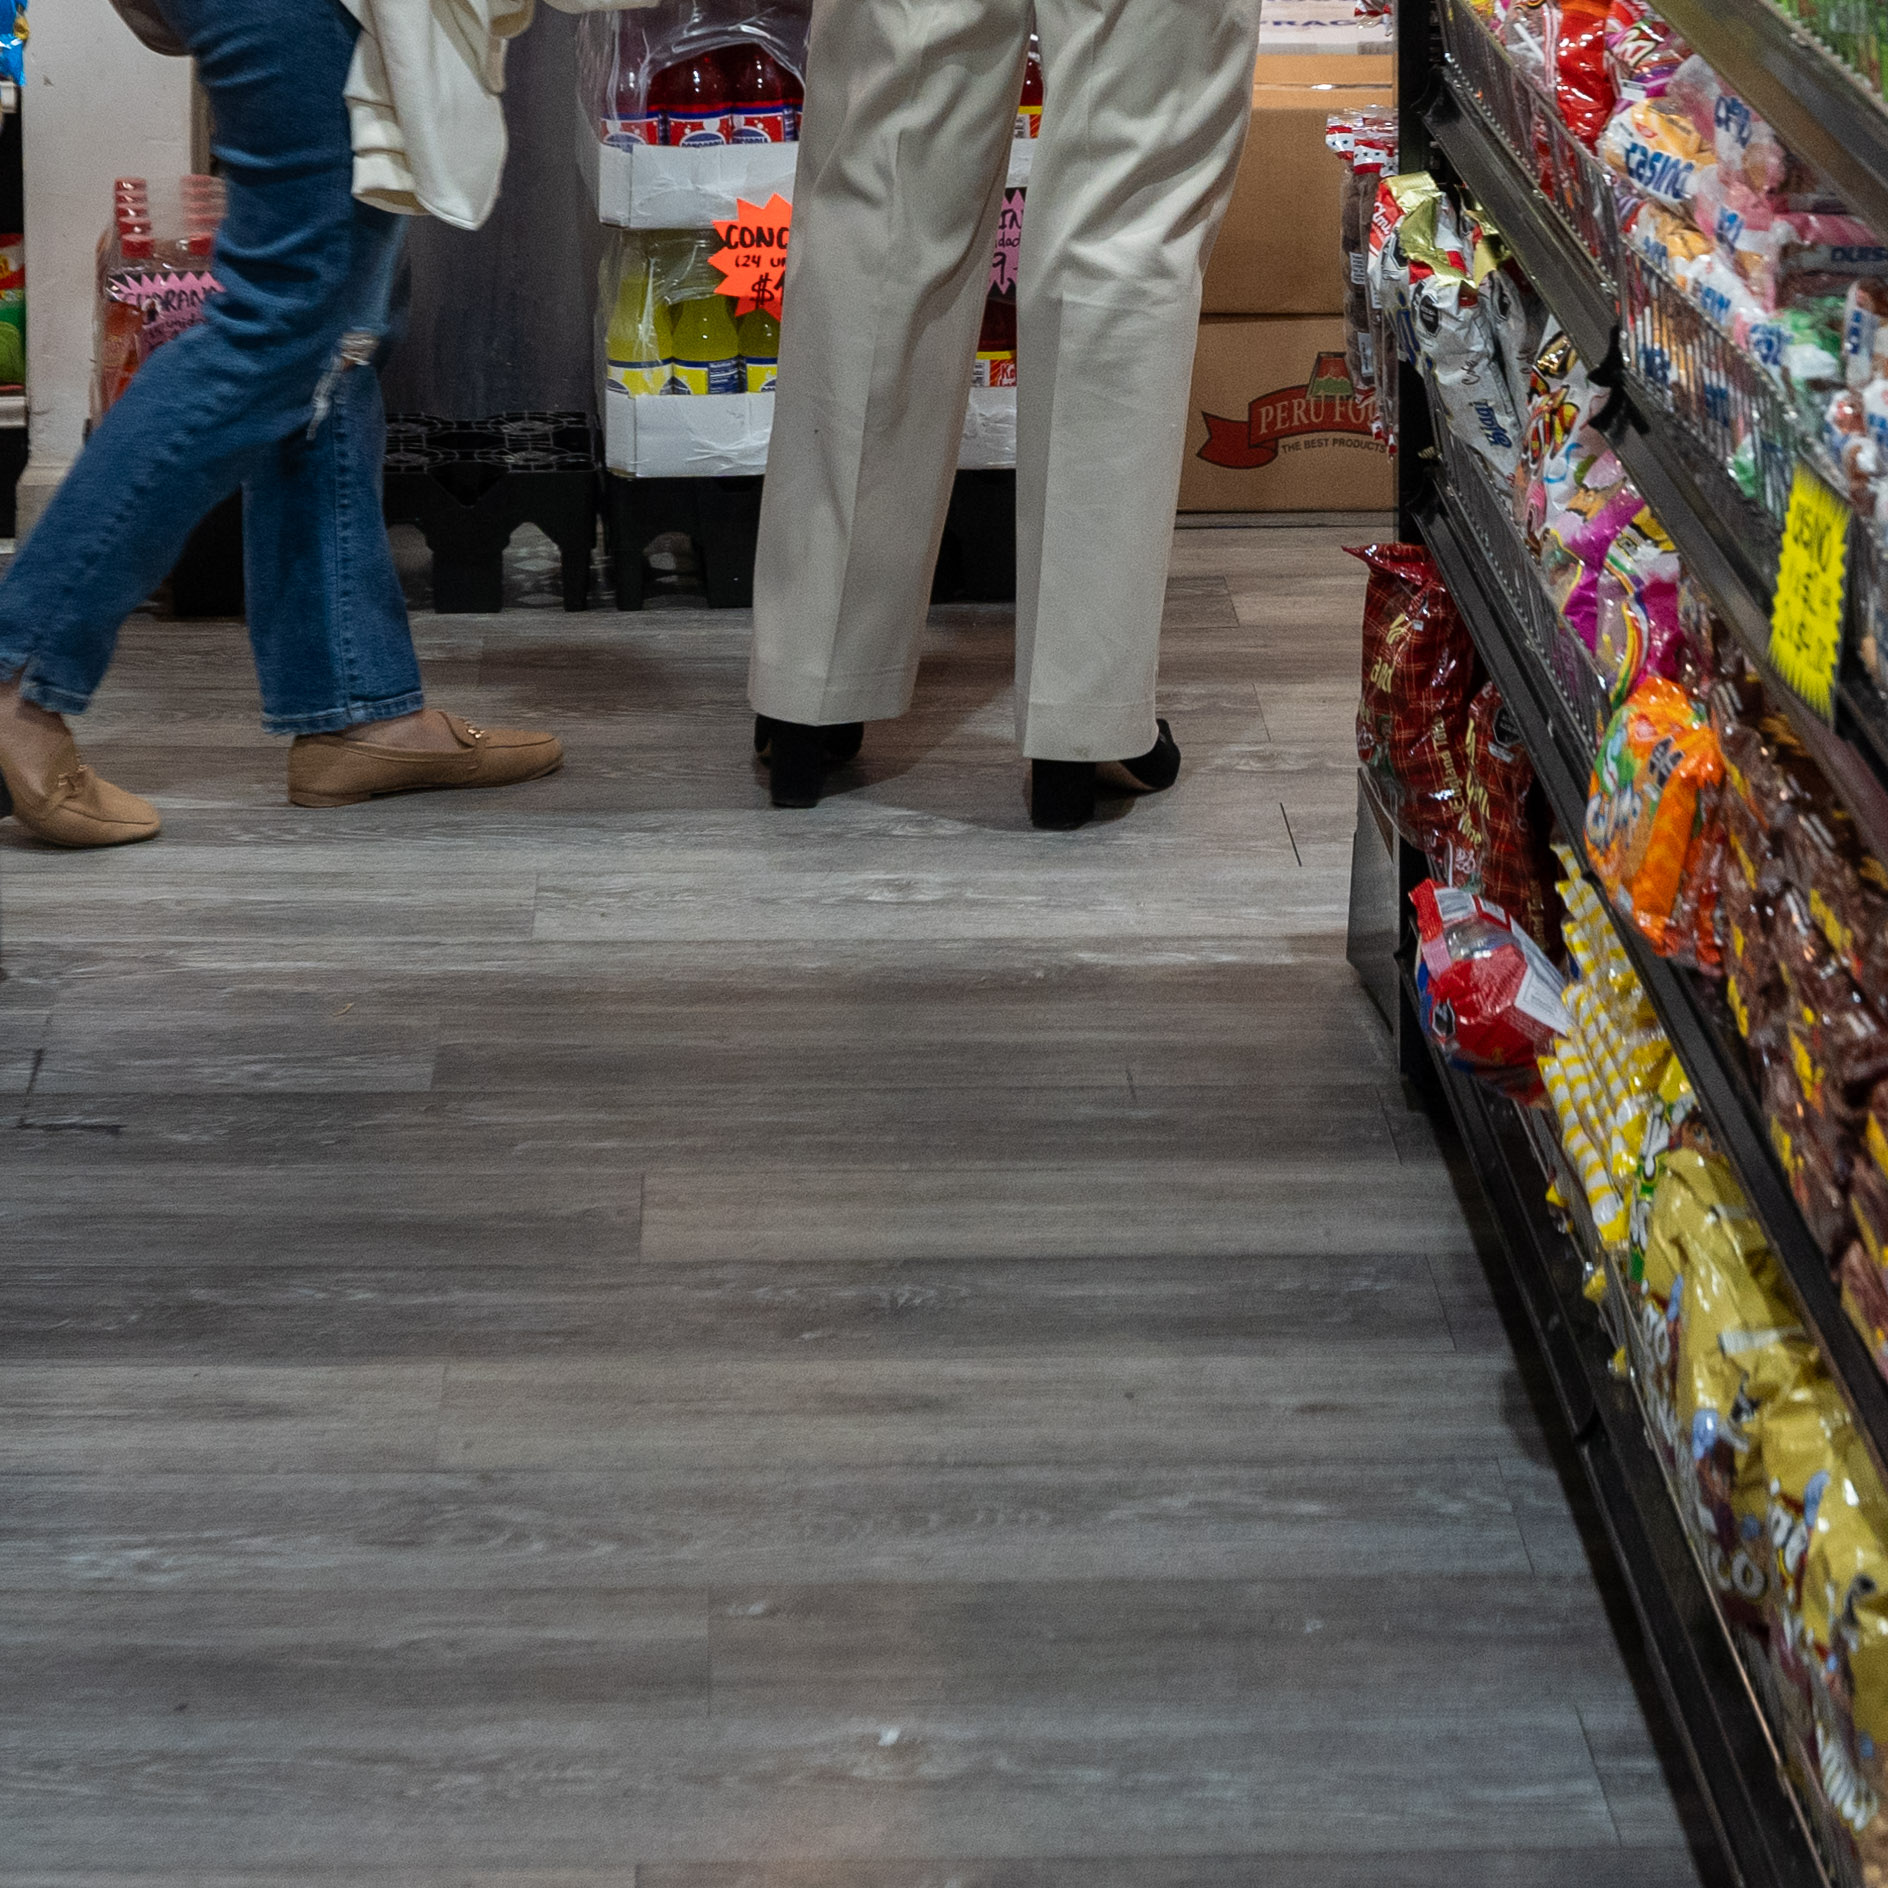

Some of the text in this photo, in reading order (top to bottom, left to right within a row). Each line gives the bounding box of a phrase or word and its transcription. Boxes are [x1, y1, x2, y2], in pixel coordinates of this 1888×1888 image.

[723, 224, 790, 251] CONC
[1280, 438, 1387, 454] THE BEST PRODUCTS
